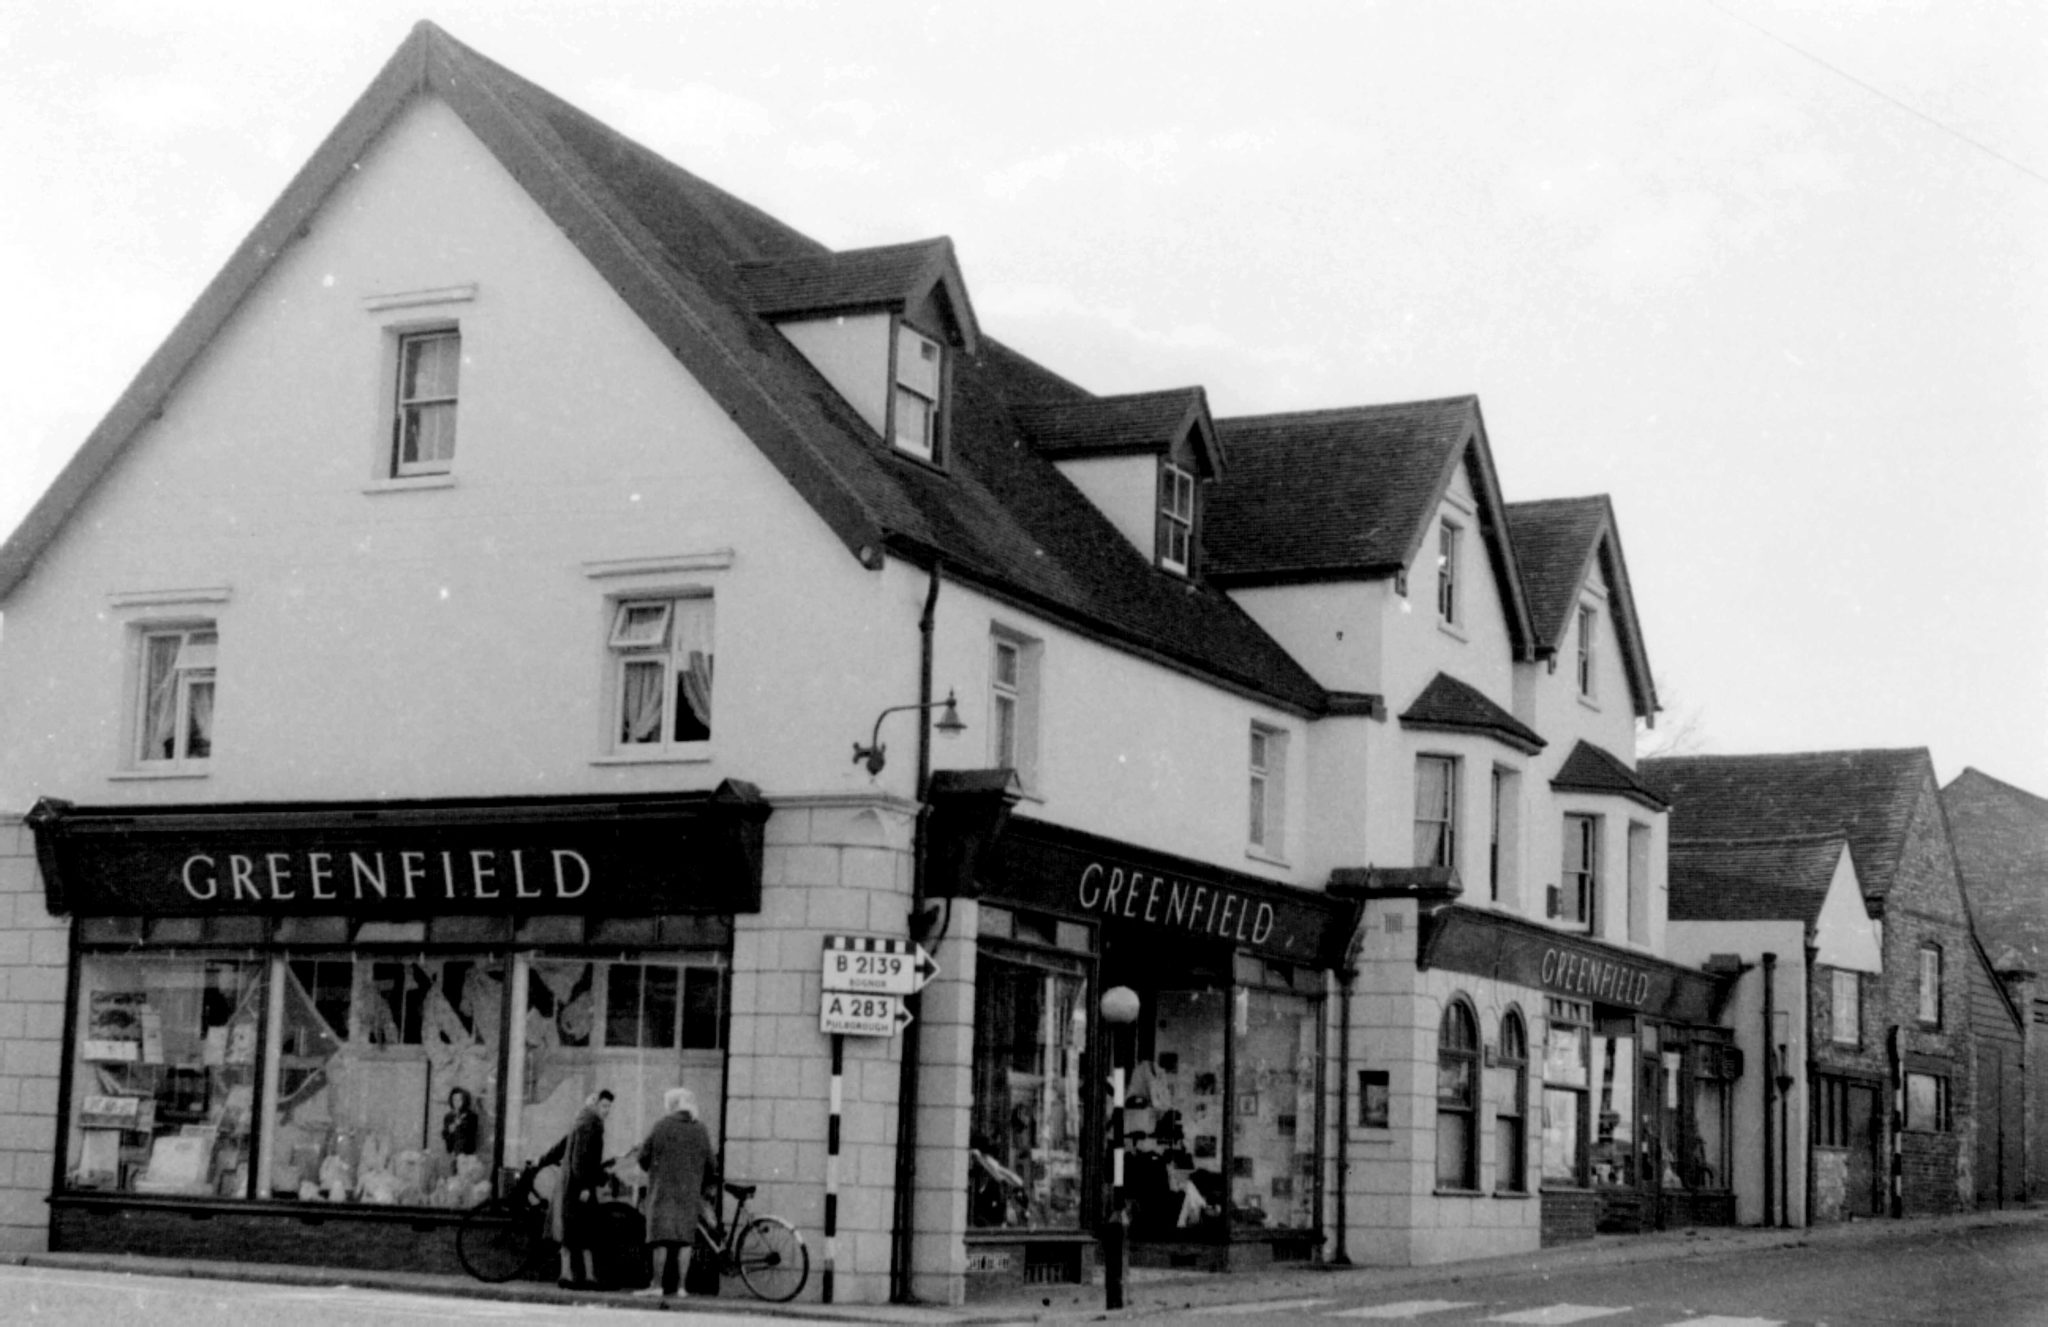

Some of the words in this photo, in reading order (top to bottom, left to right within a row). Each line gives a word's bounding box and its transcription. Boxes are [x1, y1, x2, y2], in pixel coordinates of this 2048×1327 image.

[182, 849, 591, 900] GREENFIELD
[1079, 863, 1274, 944] GREENFIELD
[836, 954, 848, 973] B
[855, 956, 902, 975] 2139
[1542, 948, 1648, 1005] GREENFIELD
[825, 1019, 889, 1031] PULBOROUGH
[829, 997, 843, 1015] A
[850, 999, 888, 1018] 283
